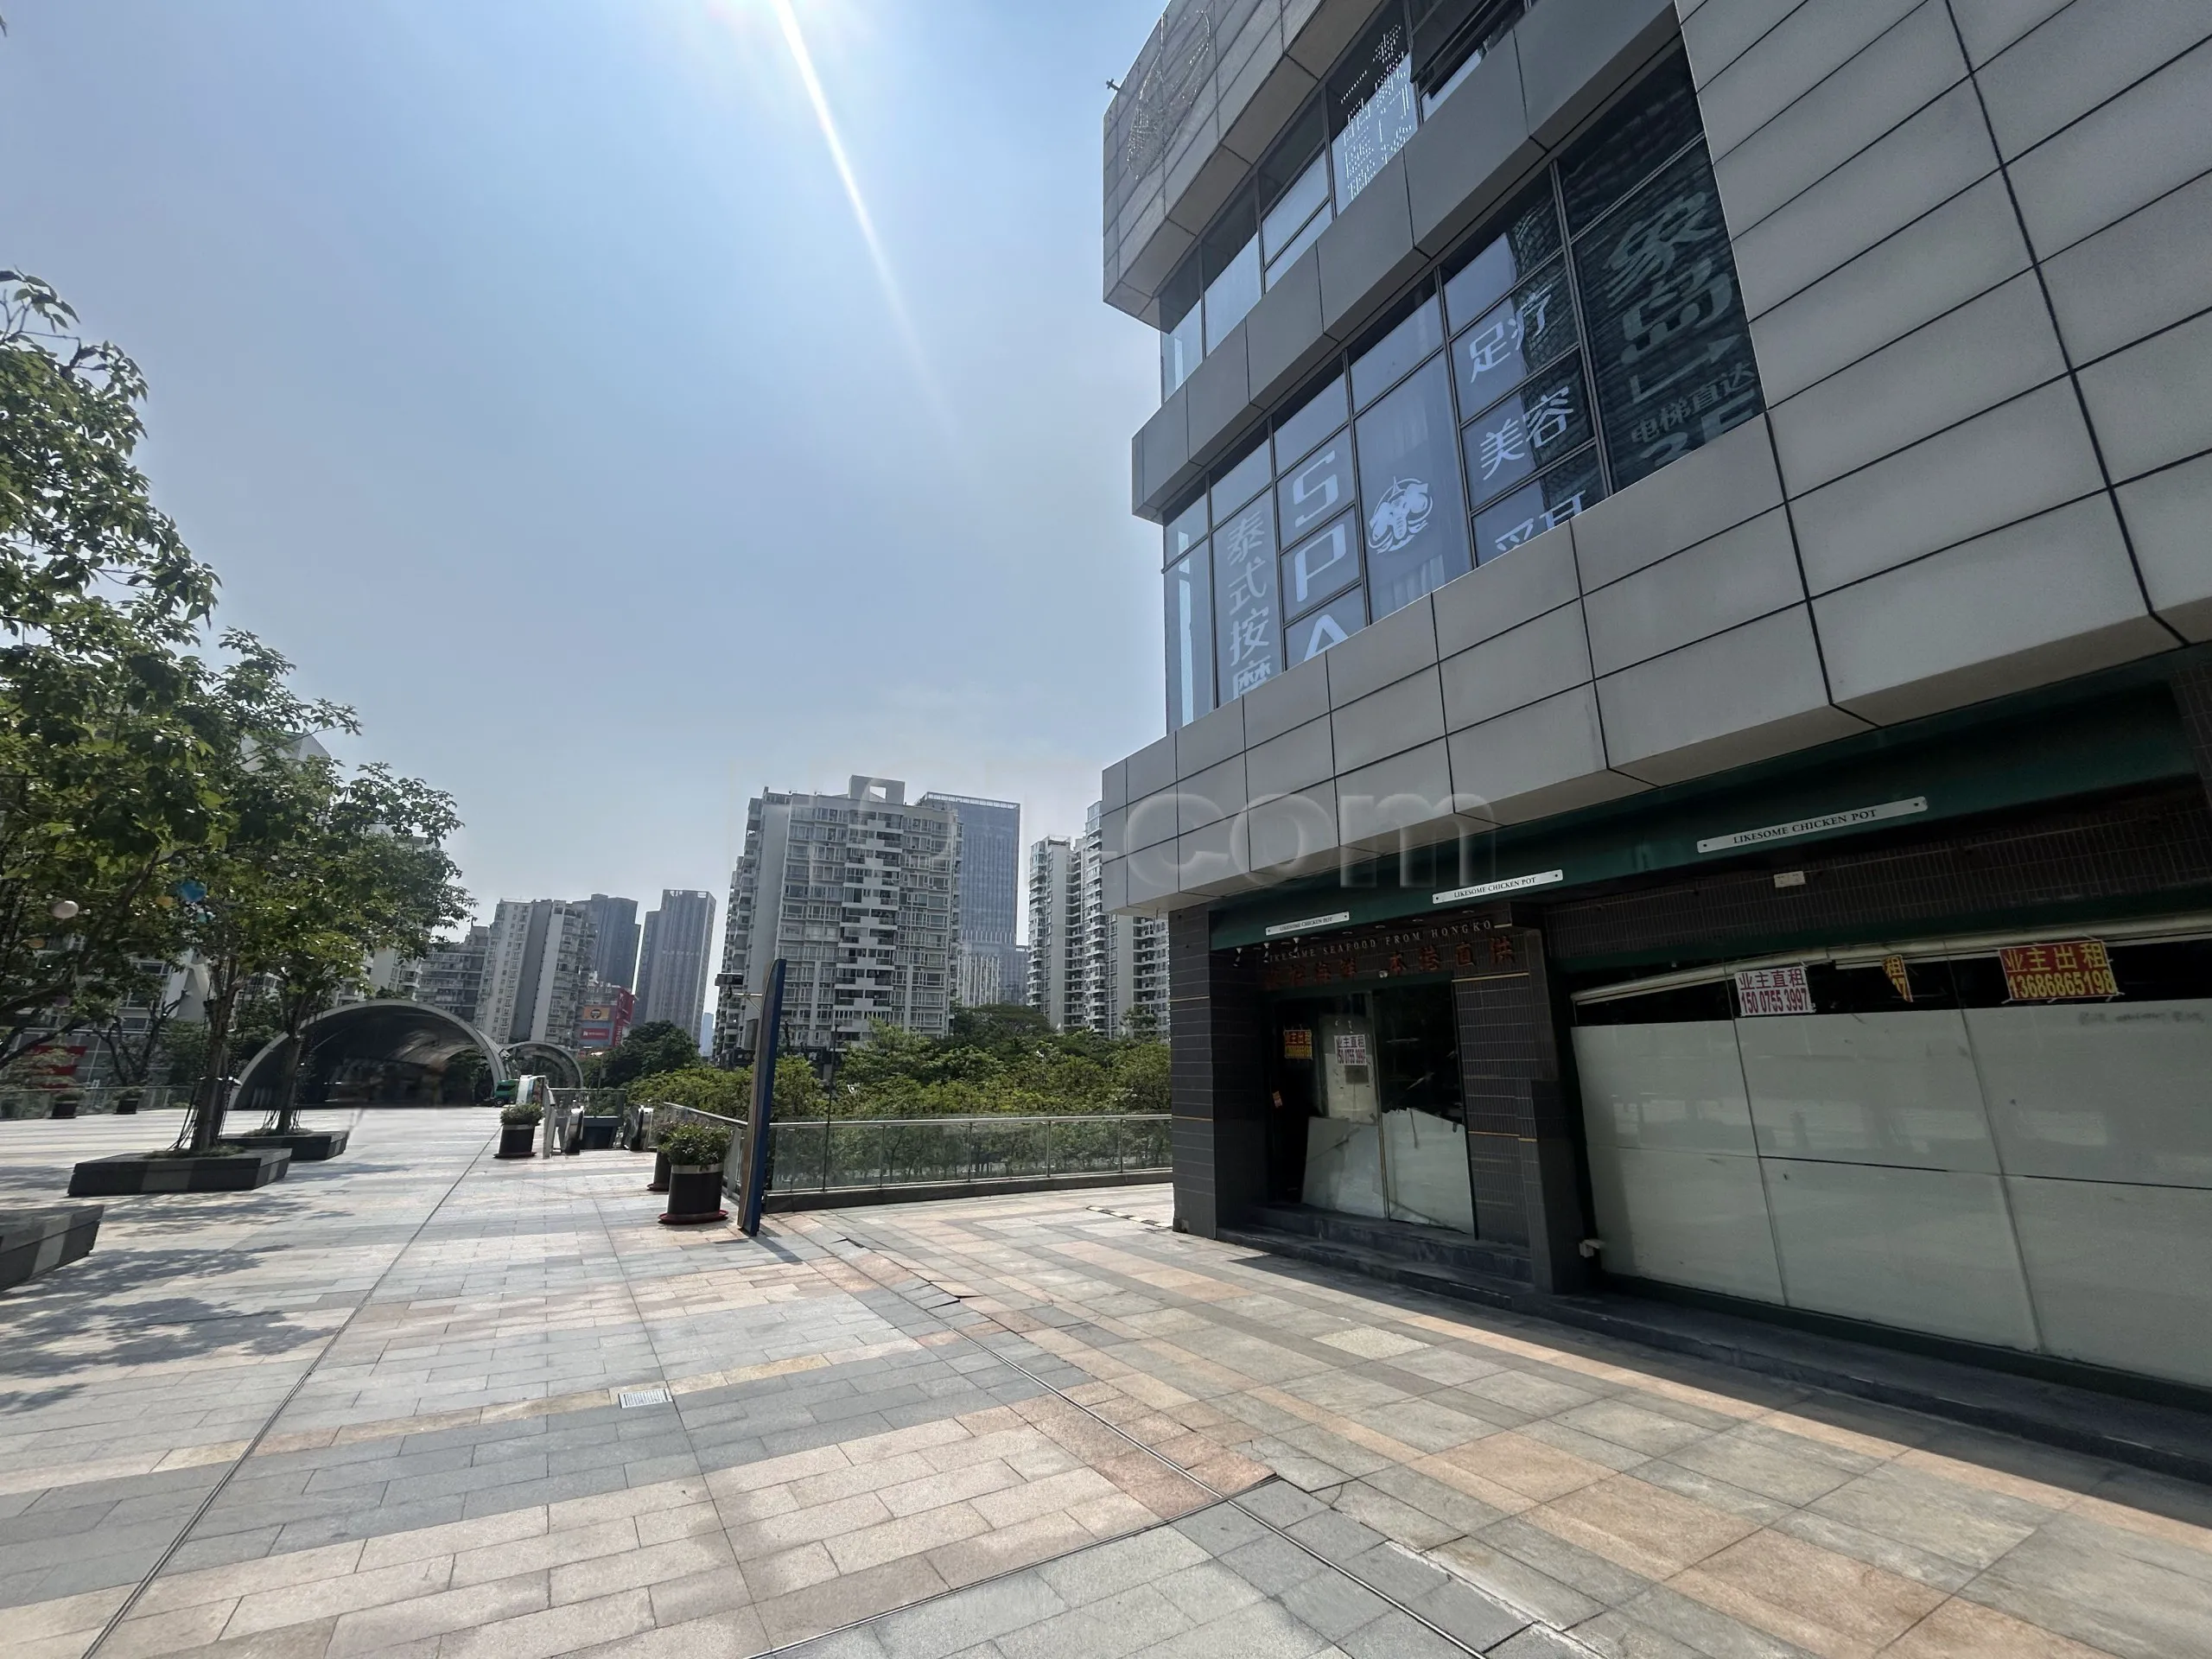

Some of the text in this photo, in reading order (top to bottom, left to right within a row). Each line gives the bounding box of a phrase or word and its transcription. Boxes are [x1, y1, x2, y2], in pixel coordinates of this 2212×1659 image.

[1470, 283, 1553, 383] 足疗
[1631, 361, 1757, 445] 电梯直达
[1480, 385, 1573, 480] 美容
[1292, 448, 1350, 661] SPA
[1732, 809, 1877, 844] LIKESOME CHICKEN POT
[1453, 877, 1536, 898] LIKESOME CHICKEN POT
[1323, 938, 1376, 955] SEAFOOD
[1386, 932, 1421, 946] FROM
[2003, 943, 2108, 973] 业主出租
[1738, 968, 1806, 991] 业主直租
[2008, 969, 2117, 999] 13686865198
[1741, 988, 1808, 1014] 150 0755 3997
